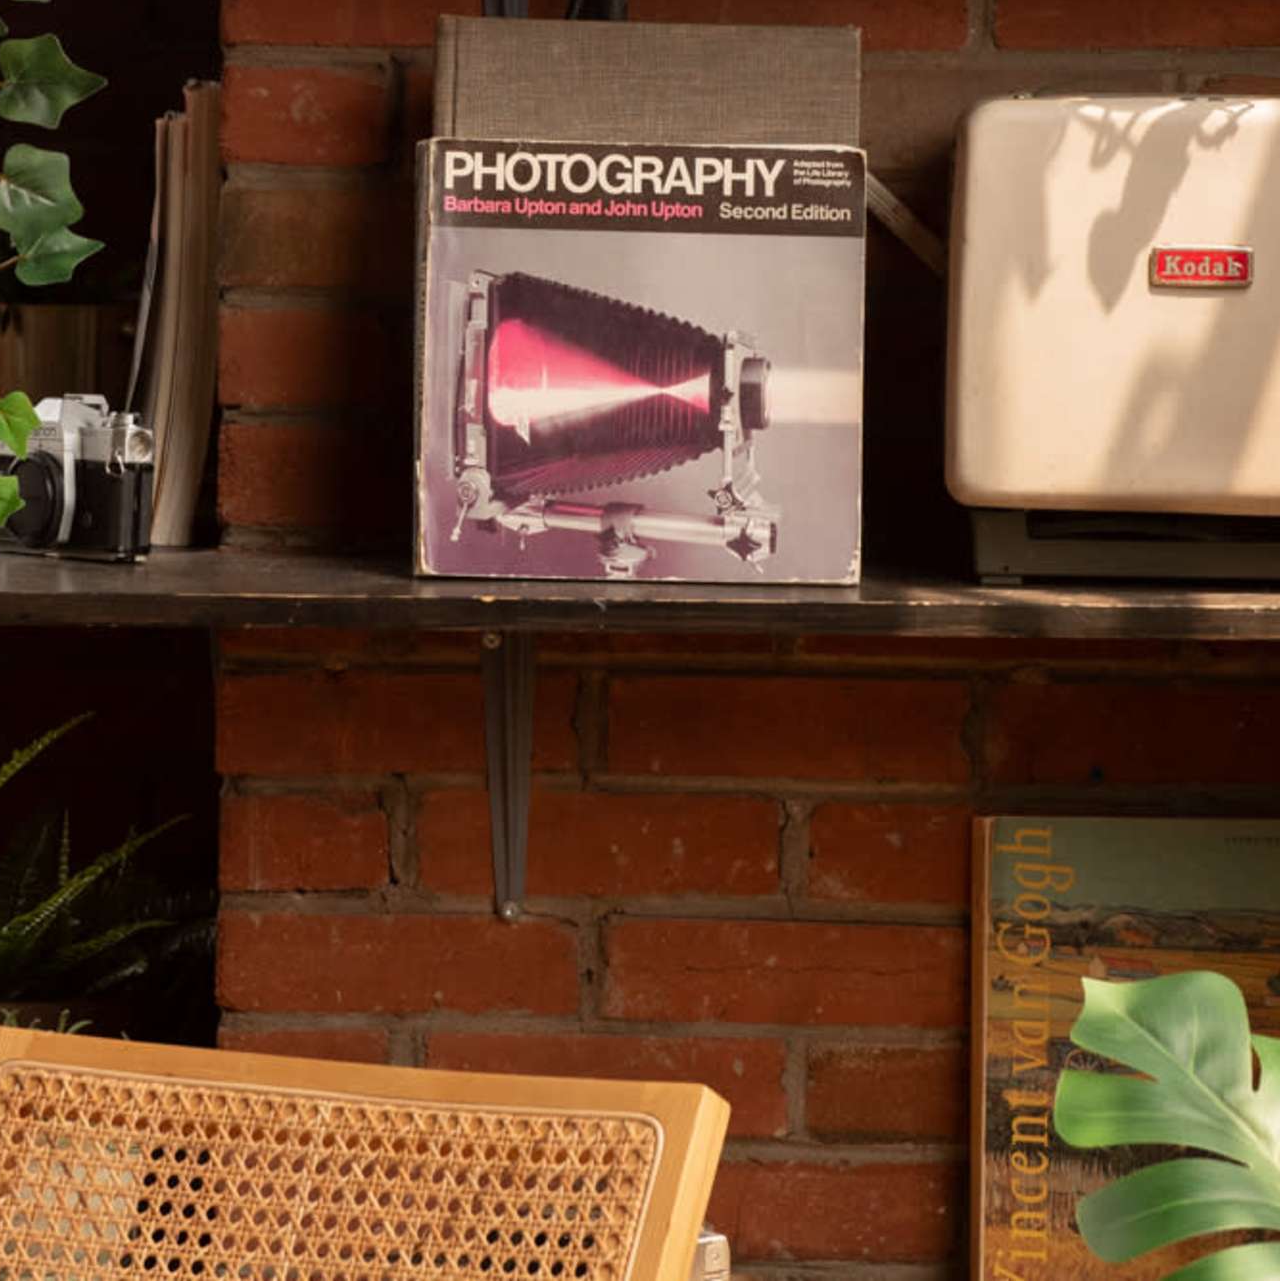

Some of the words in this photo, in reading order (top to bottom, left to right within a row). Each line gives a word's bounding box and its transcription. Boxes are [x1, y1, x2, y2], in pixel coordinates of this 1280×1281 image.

[444, 151, 785, 197] PHOTOGRAPHY
[803, 178, 852, 188] Photography
[444, 196, 511, 214] Barbara
[515, 198, 567, 217] Upton
[569, 200, 602, 216] and
[605, 200, 649, 217] John
[653, 201, 703, 219] Upton
[720, 203, 788, 220] Second
[791, 204, 851, 221] Edition
[1164, 255, 1240, 276] Kodak
[996, 828, 1075, 966] Gogh
[1013, 981, 1052, 1077] van
